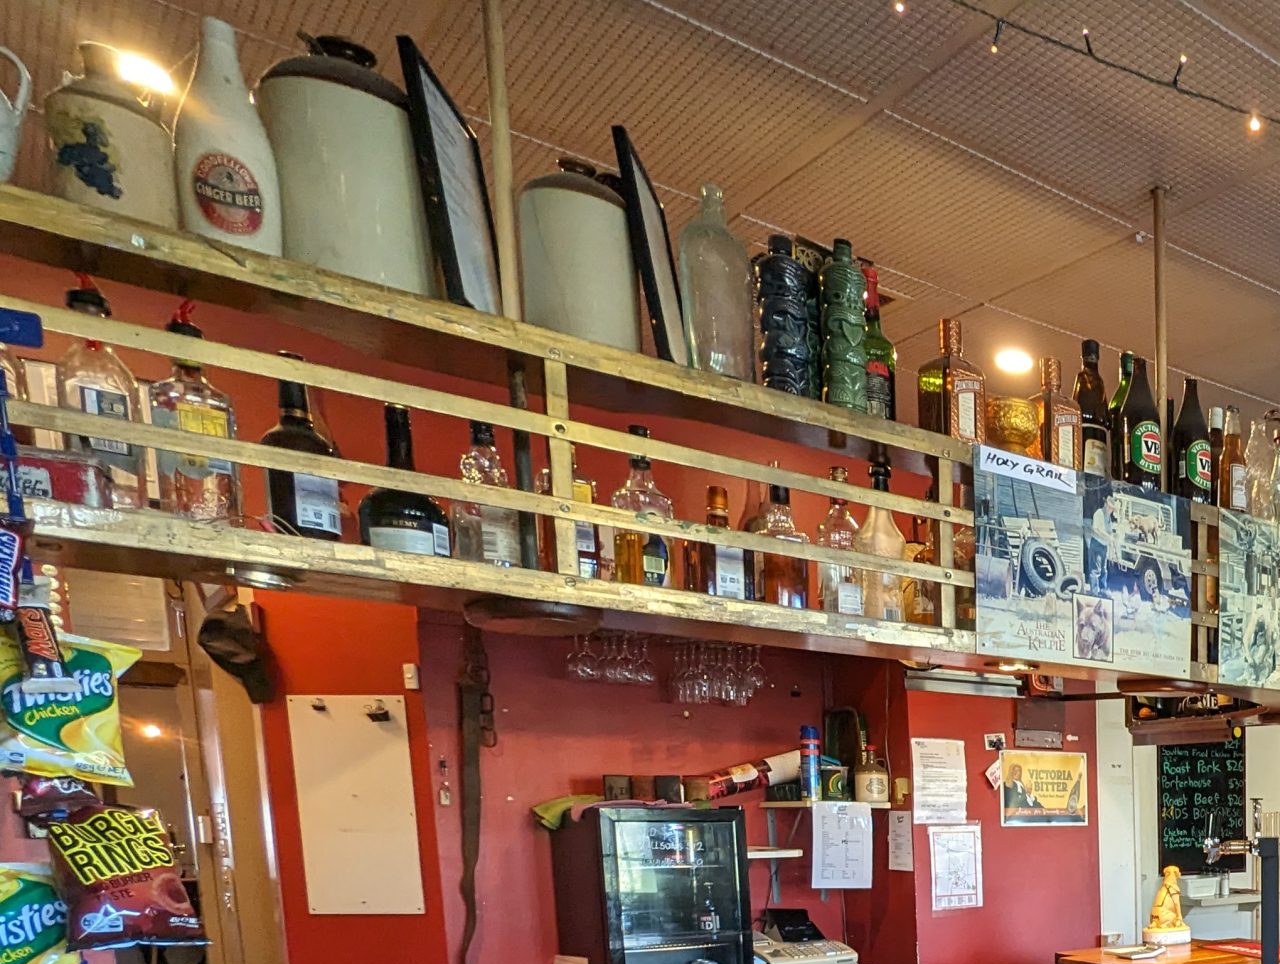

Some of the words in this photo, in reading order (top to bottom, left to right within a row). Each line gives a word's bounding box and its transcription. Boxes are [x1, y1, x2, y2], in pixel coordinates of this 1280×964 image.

[196, 182, 233, 204] GINGER
[235, 193, 262, 207] BEER
[986, 451, 1019, 471] HOLY
[1023, 464, 1074, 489] GRAIL
[1017, 623, 1066, 639] AUSTRALIAN
[1028, 636, 1066, 651] KELPIE
[1027, 769, 1074, 781] VICTORIA
[1163, 761, 1191, 775] Roast
[1197, 760, 1221, 774] Pork
[1034, 782, 1069, 793] BITTER
[1161, 775, 1212, 791] Porterhouse
[1162, 793, 1188, 807] Roast
[1194, 792, 1220, 806] Beef
[49, 809, 164, 852] BURGE
[67, 835, 173, 885] RINGS
